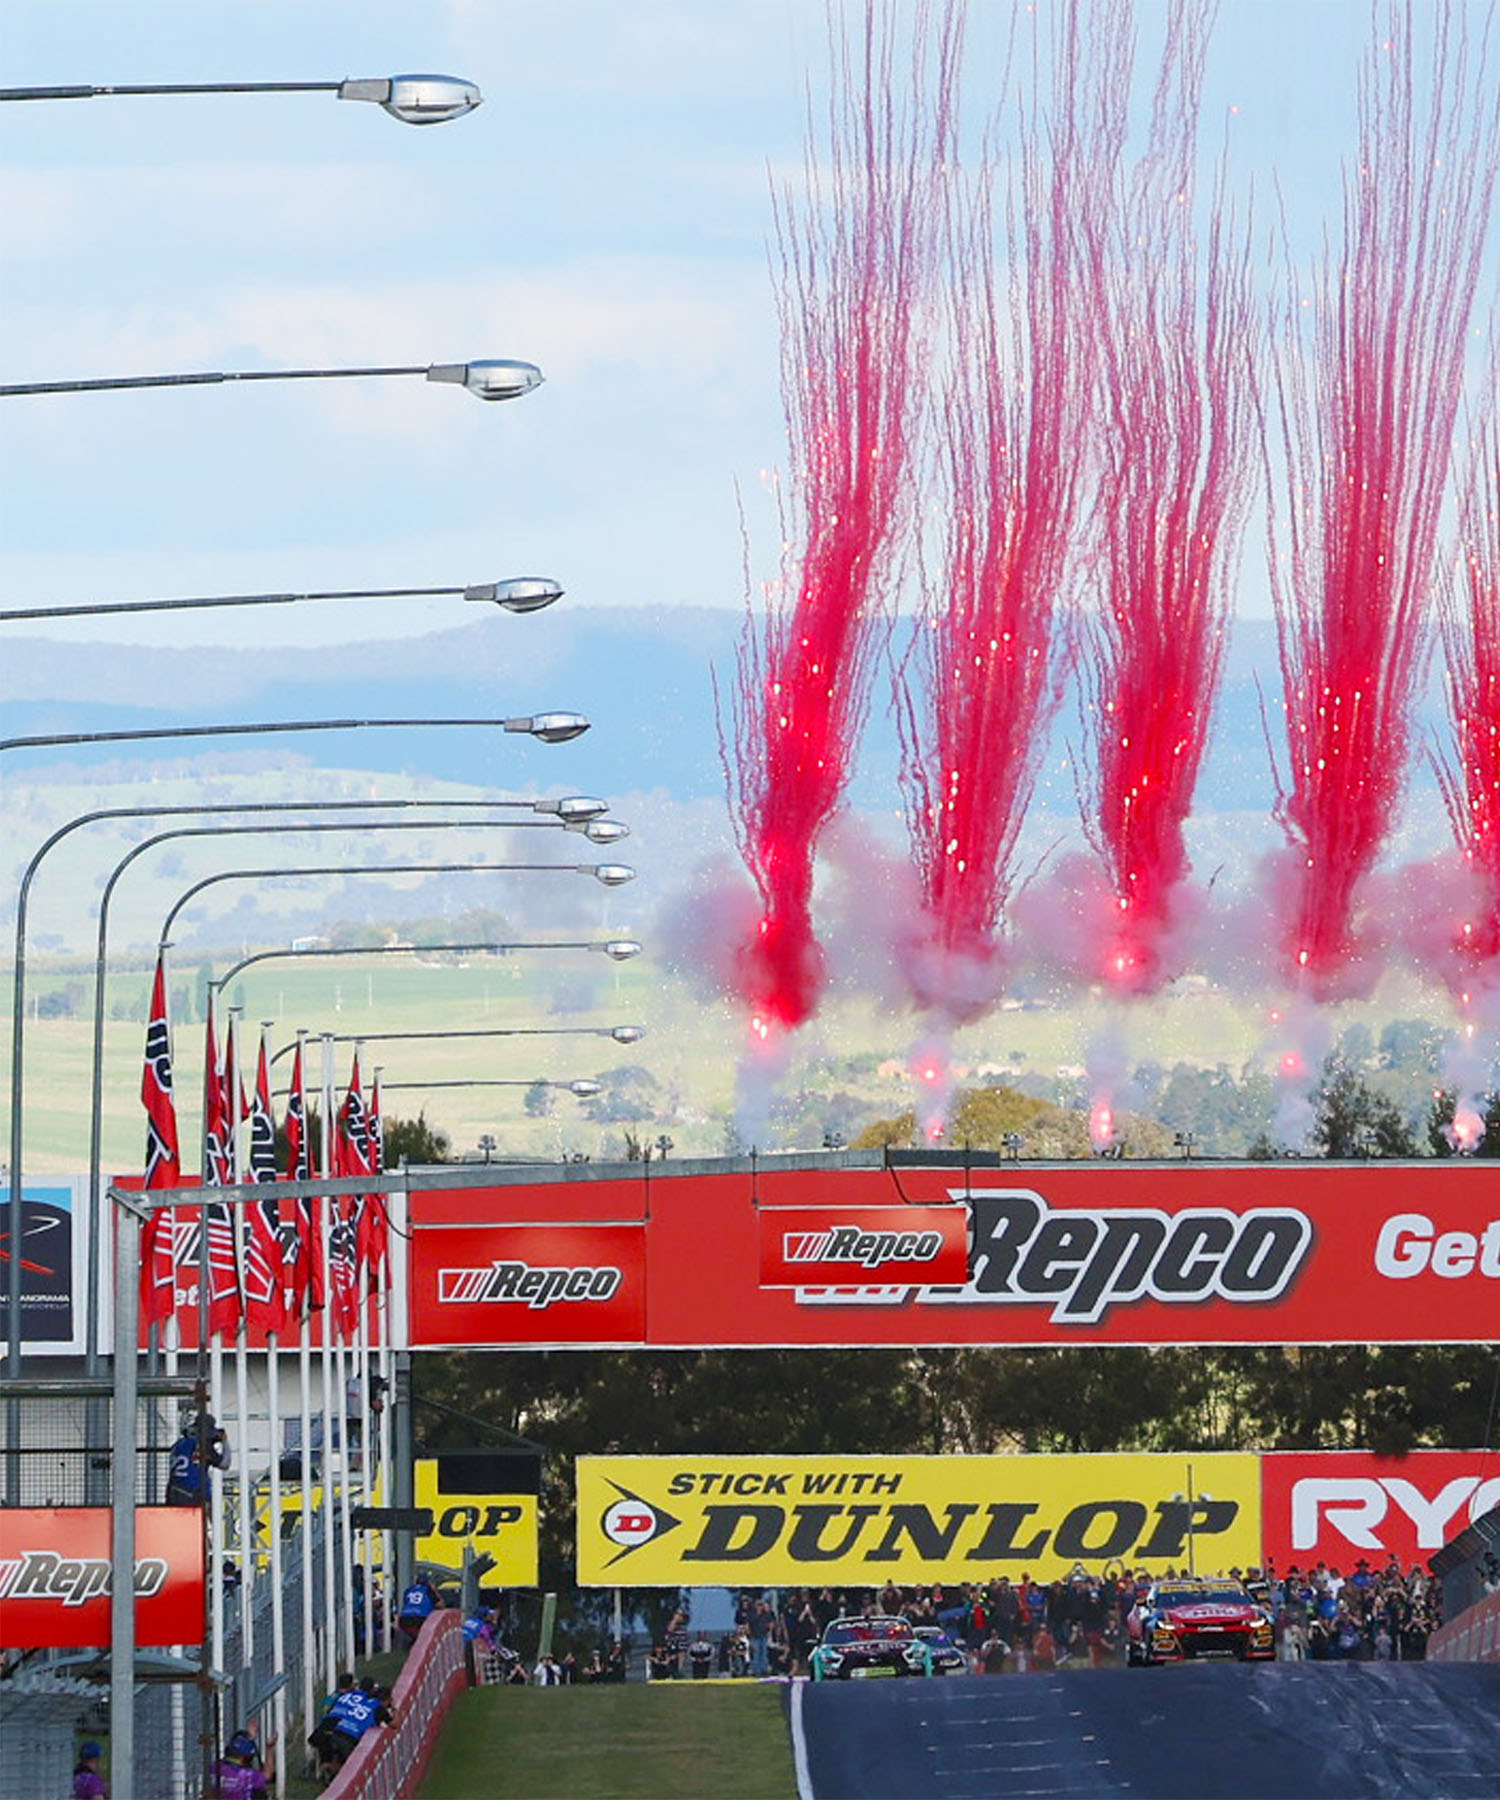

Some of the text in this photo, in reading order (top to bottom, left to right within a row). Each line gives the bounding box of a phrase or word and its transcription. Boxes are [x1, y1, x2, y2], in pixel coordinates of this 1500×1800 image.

[830, 1226, 943, 1268] Repco
[947, 1188, 1312, 1323] Repco
[480, 1260, 623, 1309] Repco
[668, 1473, 903, 1495] STICK WITH
[614, 1515, 652, 1532] D
[680, 1501, 1239, 1562] DUNLOP
[9, 1551, 168, 1606] Repo
